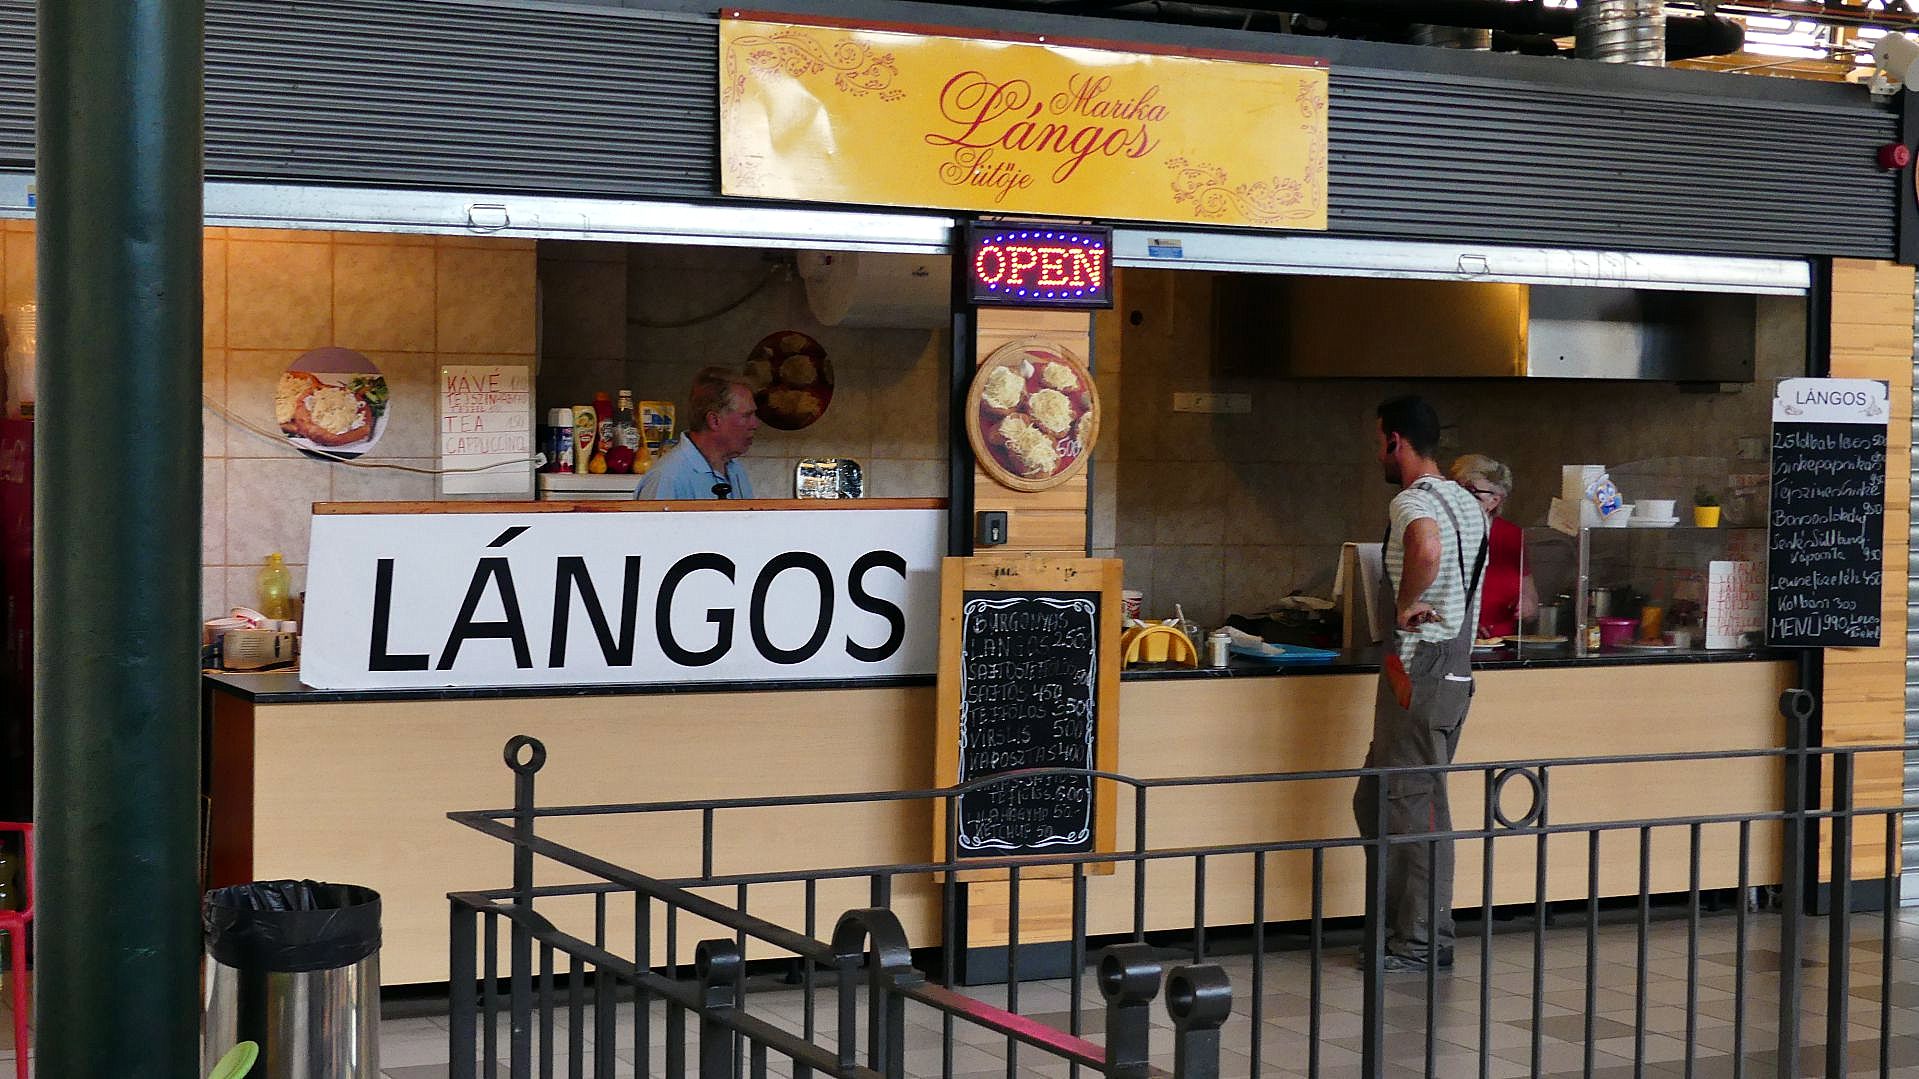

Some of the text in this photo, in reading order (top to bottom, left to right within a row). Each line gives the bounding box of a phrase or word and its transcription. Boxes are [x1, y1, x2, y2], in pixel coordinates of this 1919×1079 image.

[1050, 72, 1170, 122] Marika
[924, 70, 1161, 184] Lángos
[938, 147, 1035, 204] Sütője
[976, 246, 1105, 287] OPEN
[447, 368, 500, 393] KÁVÉ
[1796, 388, 1867, 406] LÁNGOS
[444, 415, 484, 432] TEA
[368, 526, 908, 673] LÁNGOS
[1822, 614, 1848, 631] 990
